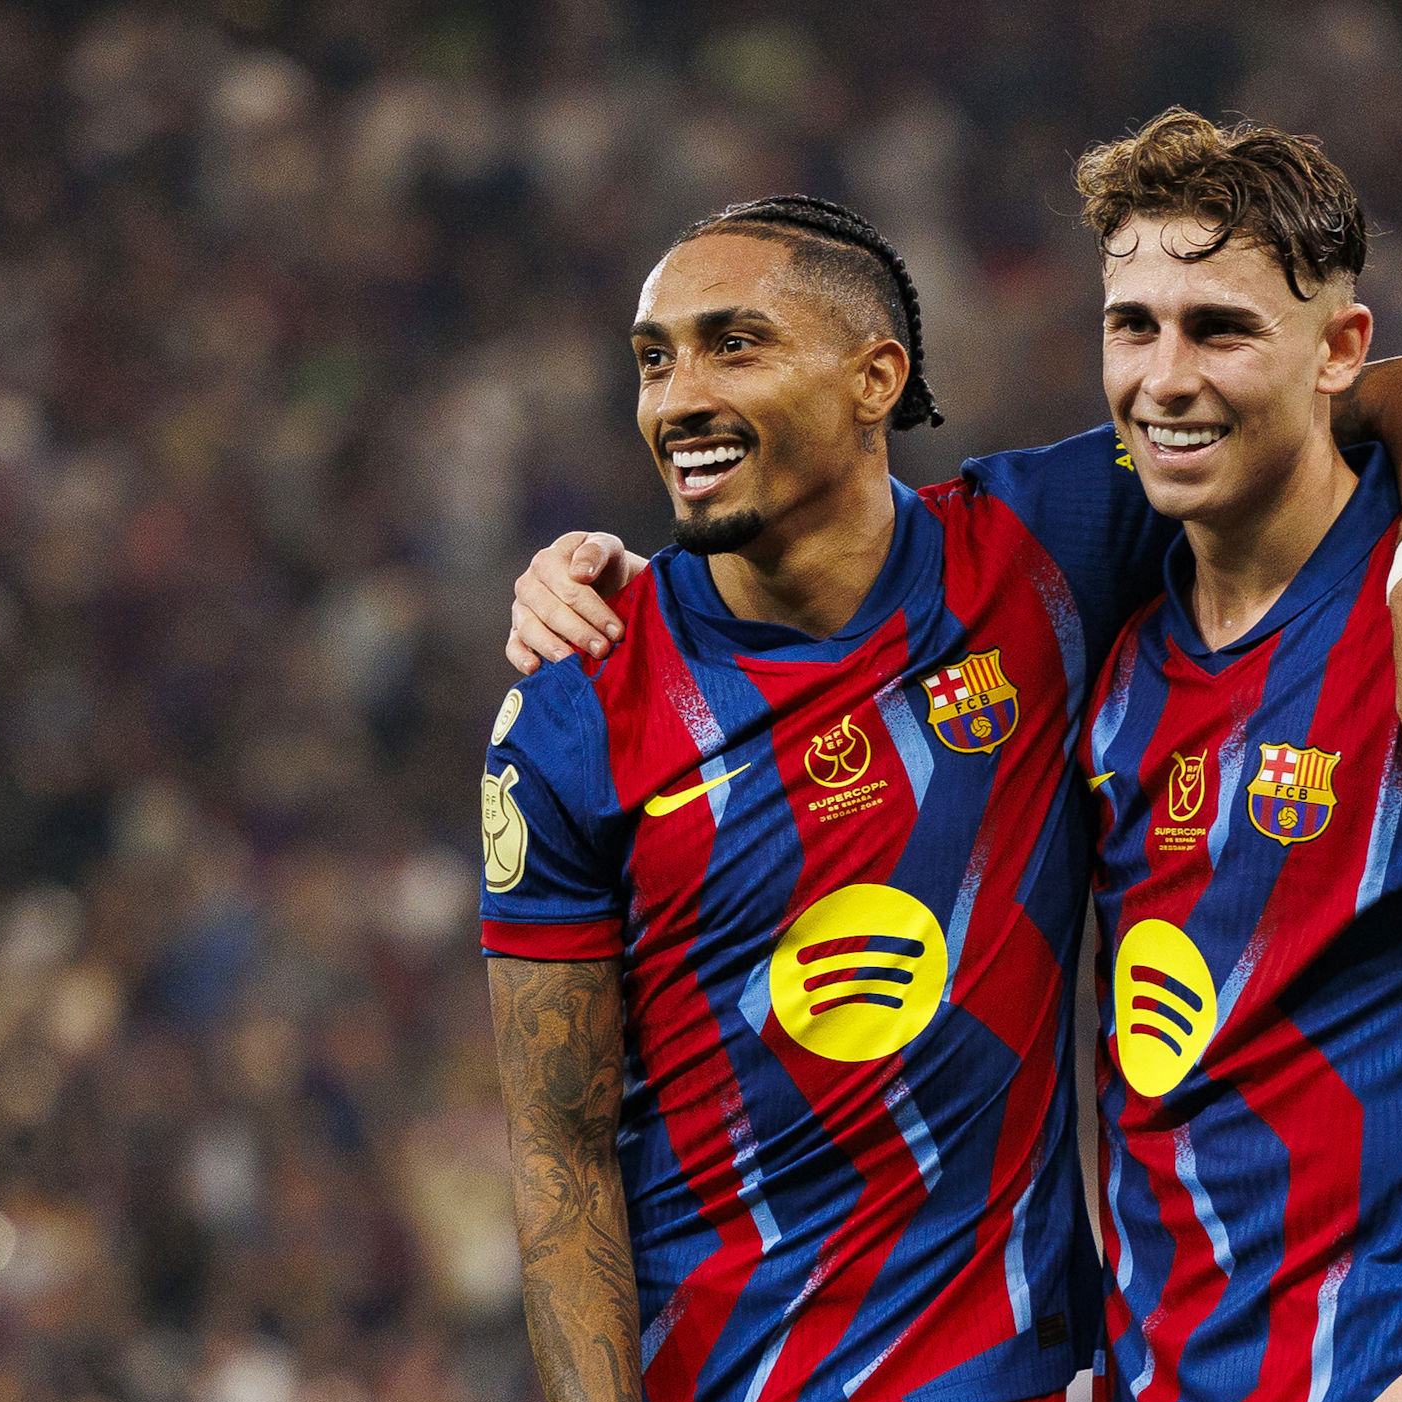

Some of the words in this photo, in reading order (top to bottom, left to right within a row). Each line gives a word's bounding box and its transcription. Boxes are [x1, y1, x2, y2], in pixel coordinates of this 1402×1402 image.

[954, 694, 990, 714] FCB
[808, 779, 888, 811] SUPERCOPA
[1275, 785, 1308, 800] FCB
[819, 807, 858, 822] JEDDAH
[1154, 827, 1206, 836] SUPERCOPA
